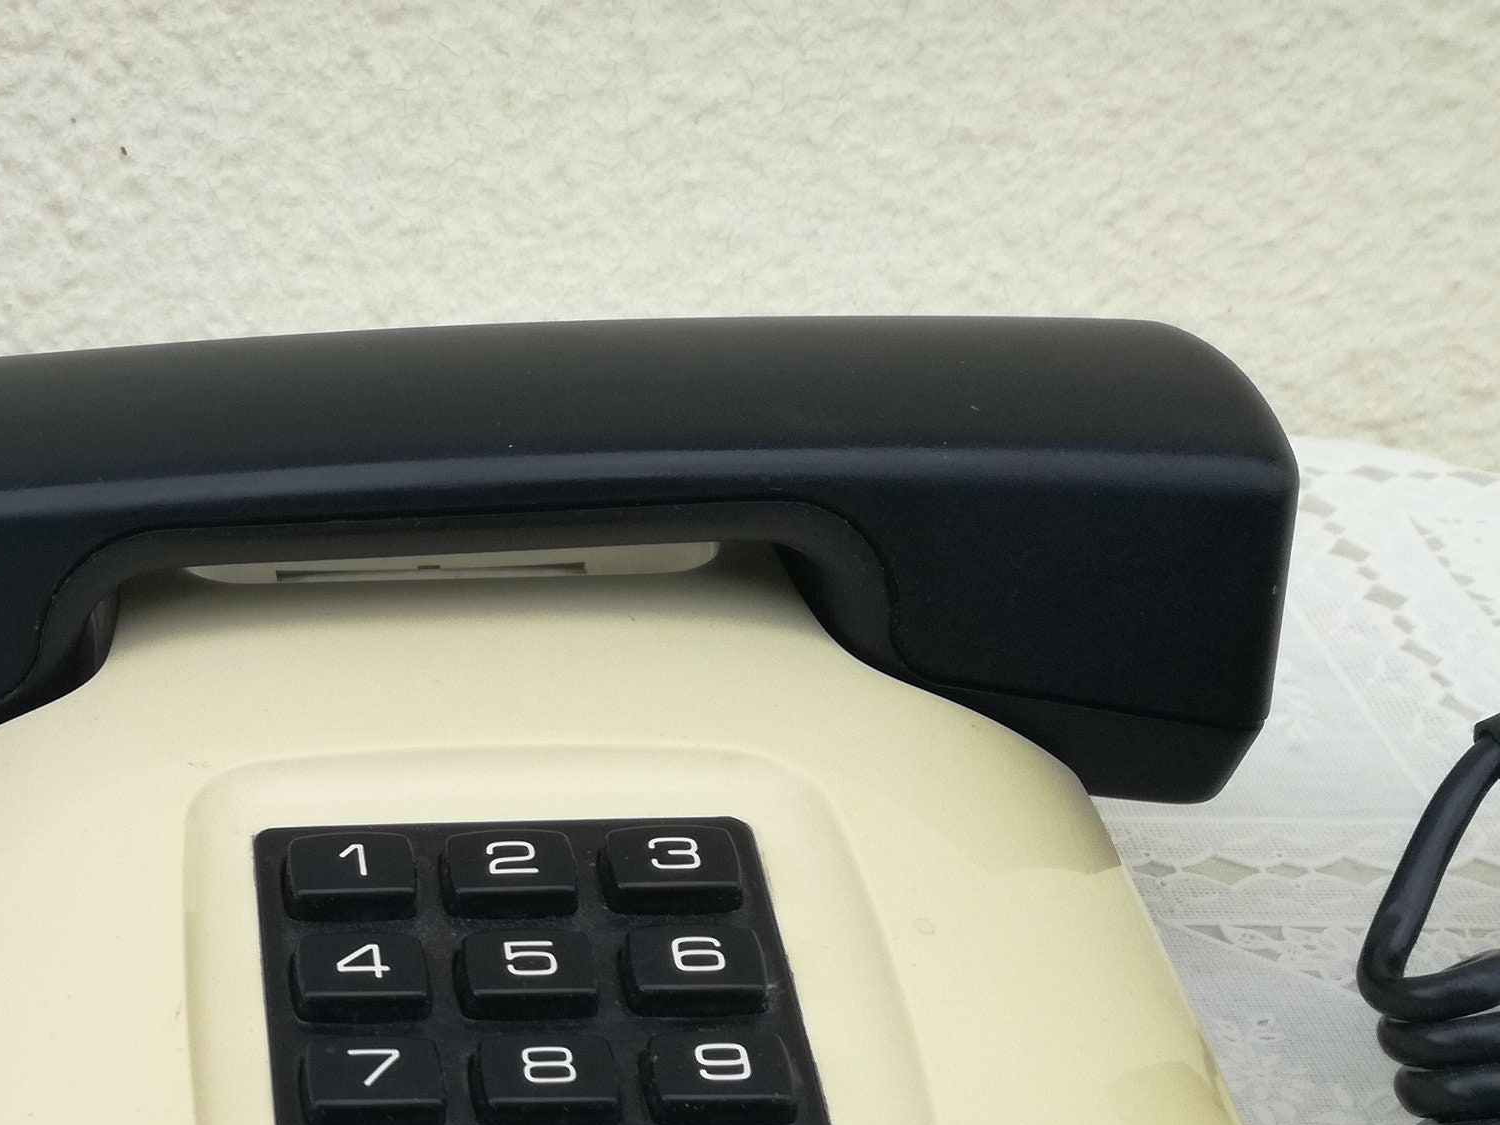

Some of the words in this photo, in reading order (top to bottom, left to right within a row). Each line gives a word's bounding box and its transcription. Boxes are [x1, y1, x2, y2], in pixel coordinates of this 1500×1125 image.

[338, 843, 368, 876] 1
[485, 840, 540, 875] 2
[647, 836, 702, 870] 3
[336, 943, 391, 979] 4
[503, 940, 558, 976] 5
[671, 936, 726, 972] 6
[346, 1048, 401, 1087] 7
[521, 1046, 577, 1084] 8
[694, 1042, 752, 1081] 9
